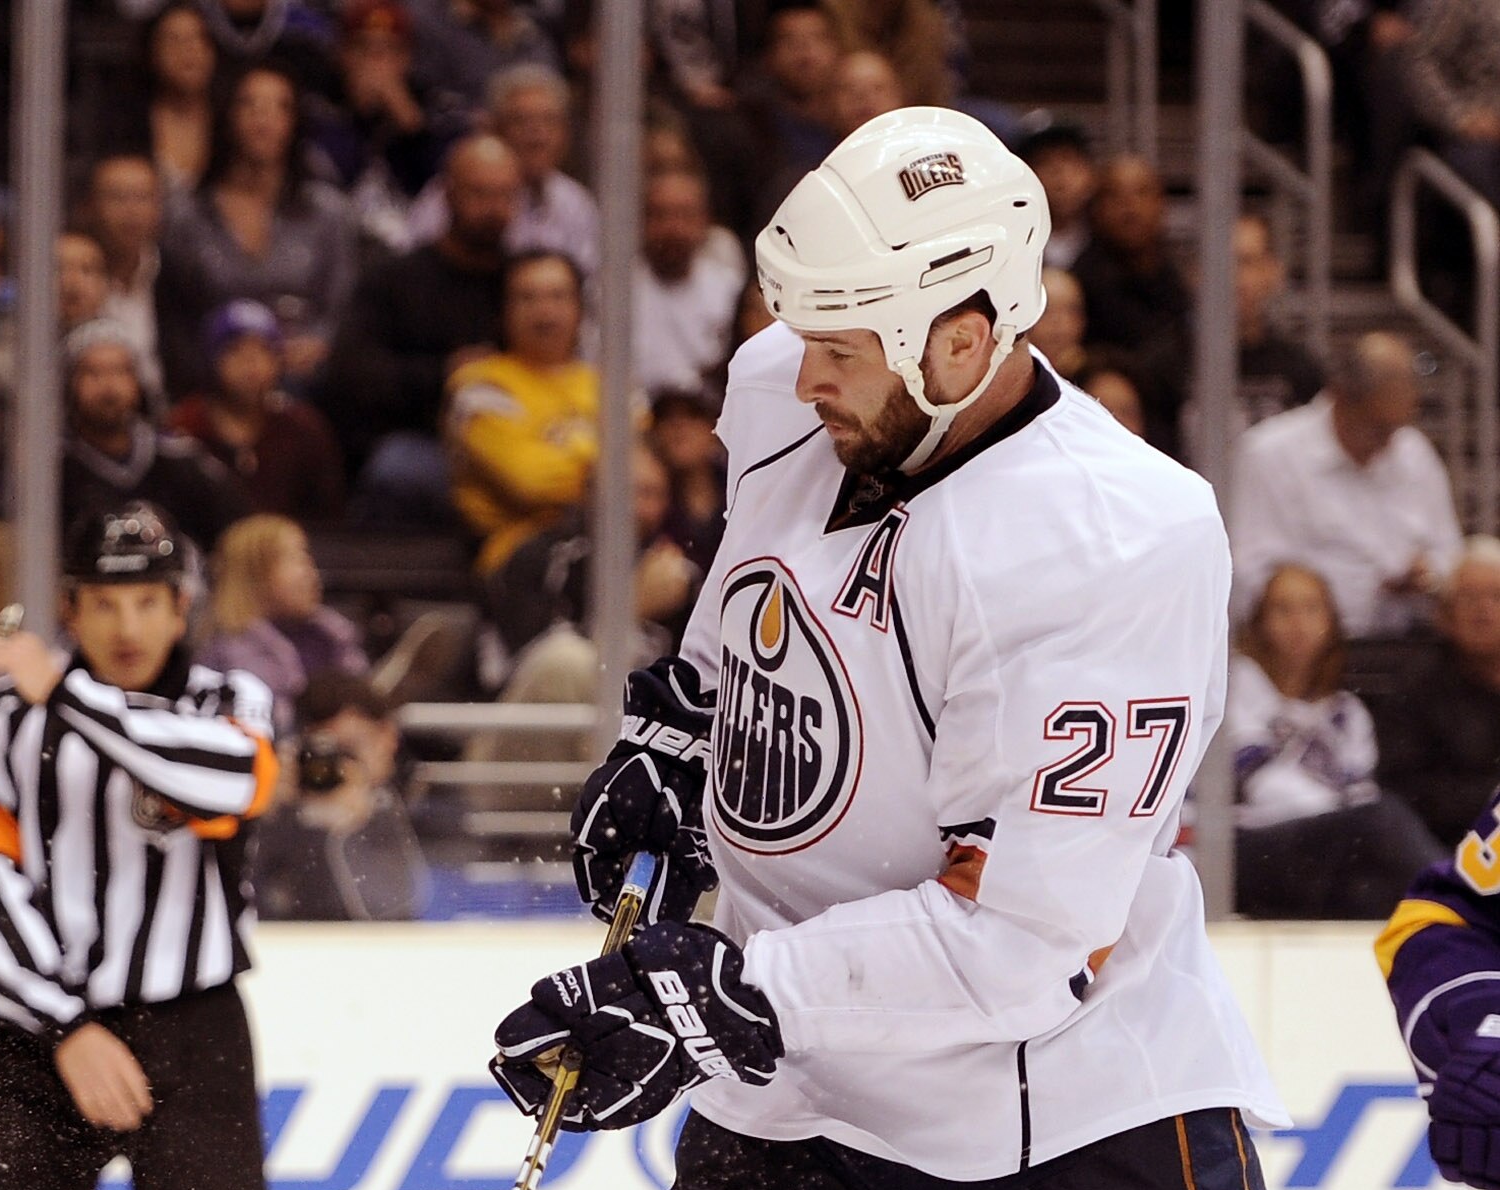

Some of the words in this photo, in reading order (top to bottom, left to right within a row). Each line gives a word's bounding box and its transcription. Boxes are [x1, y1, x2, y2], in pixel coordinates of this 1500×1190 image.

[898, 153, 965, 200] OILERS
[831, 507, 909, 633] A
[621, 714, 713, 772] UER
[715, 643, 822, 824] OILERS
[1029, 695, 1191, 818] 27
